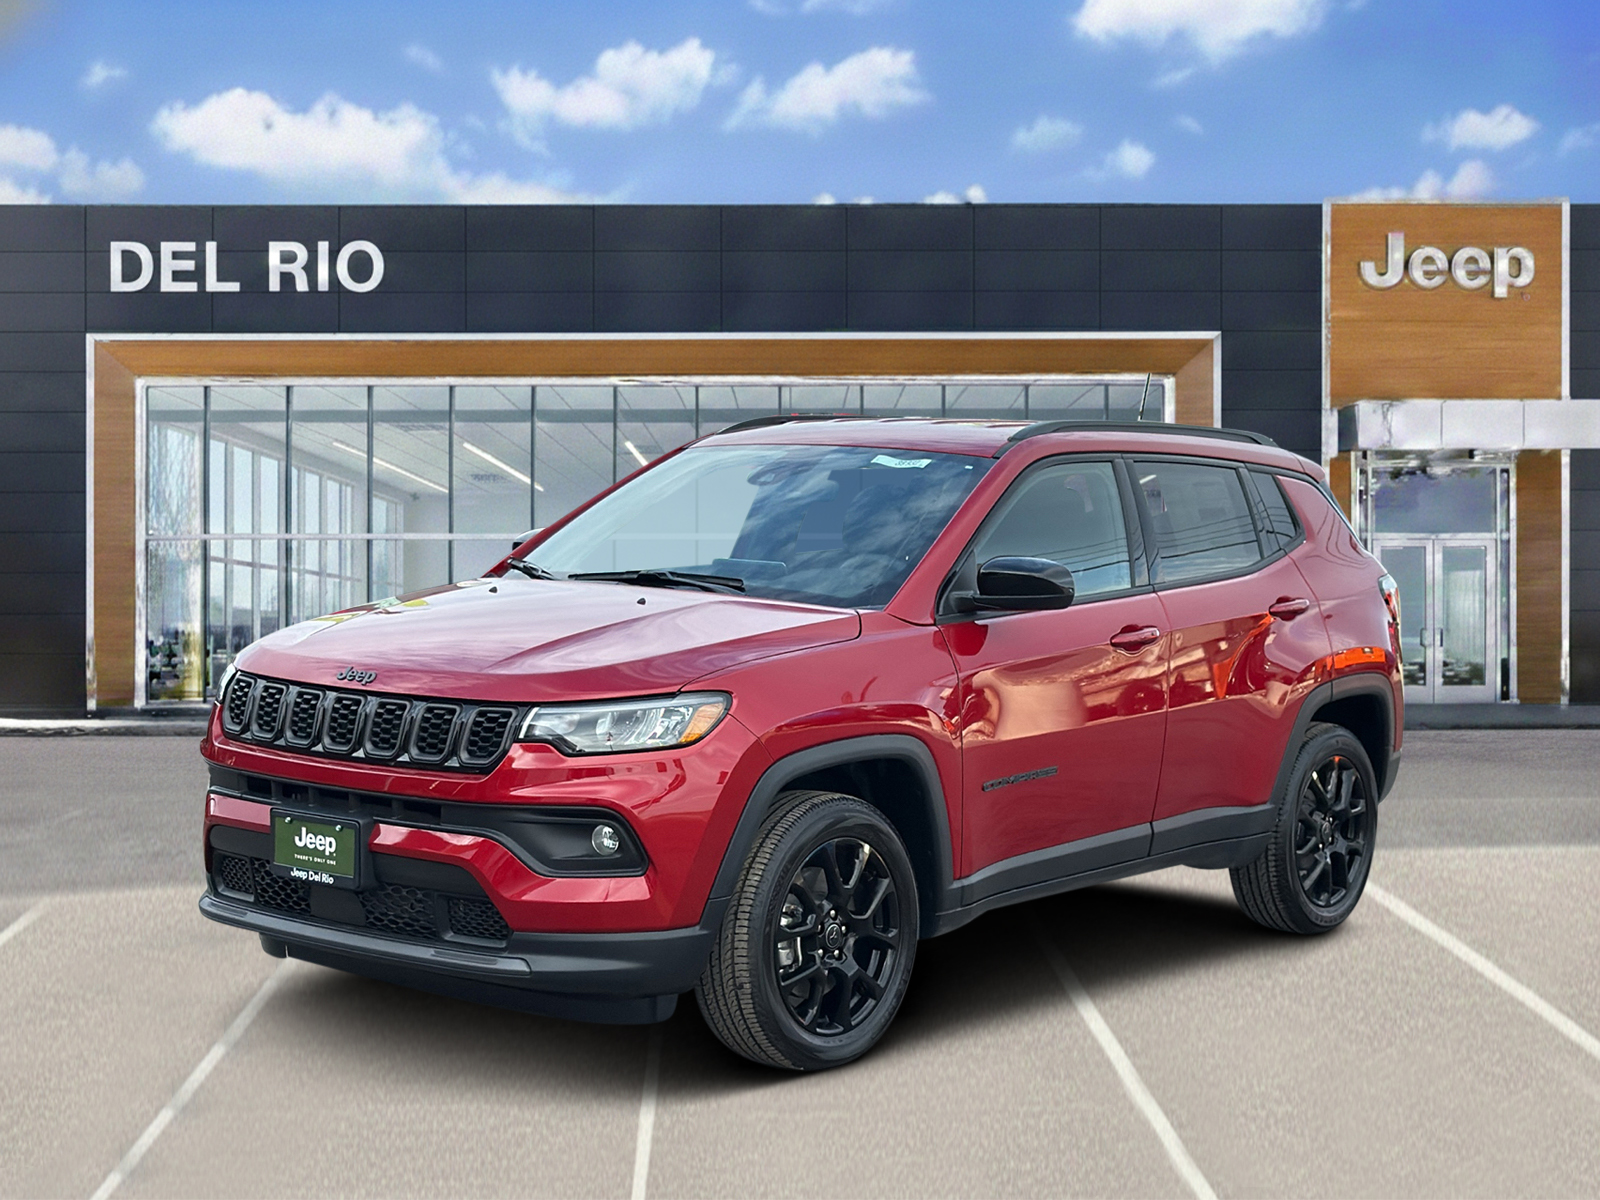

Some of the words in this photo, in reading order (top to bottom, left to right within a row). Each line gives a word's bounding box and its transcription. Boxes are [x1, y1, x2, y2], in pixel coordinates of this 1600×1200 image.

[110, 241, 240, 292] DEL
[268, 240, 384, 292] RIO
[1359, 231, 1535, 298] Jeep
[336, 666, 377, 686] Jeep
[294, 826, 337, 856] Jeep
[290, 867, 308, 880] Jeep
[308, 870, 321, 882] Del
[321, 873, 334, 884] Rio
